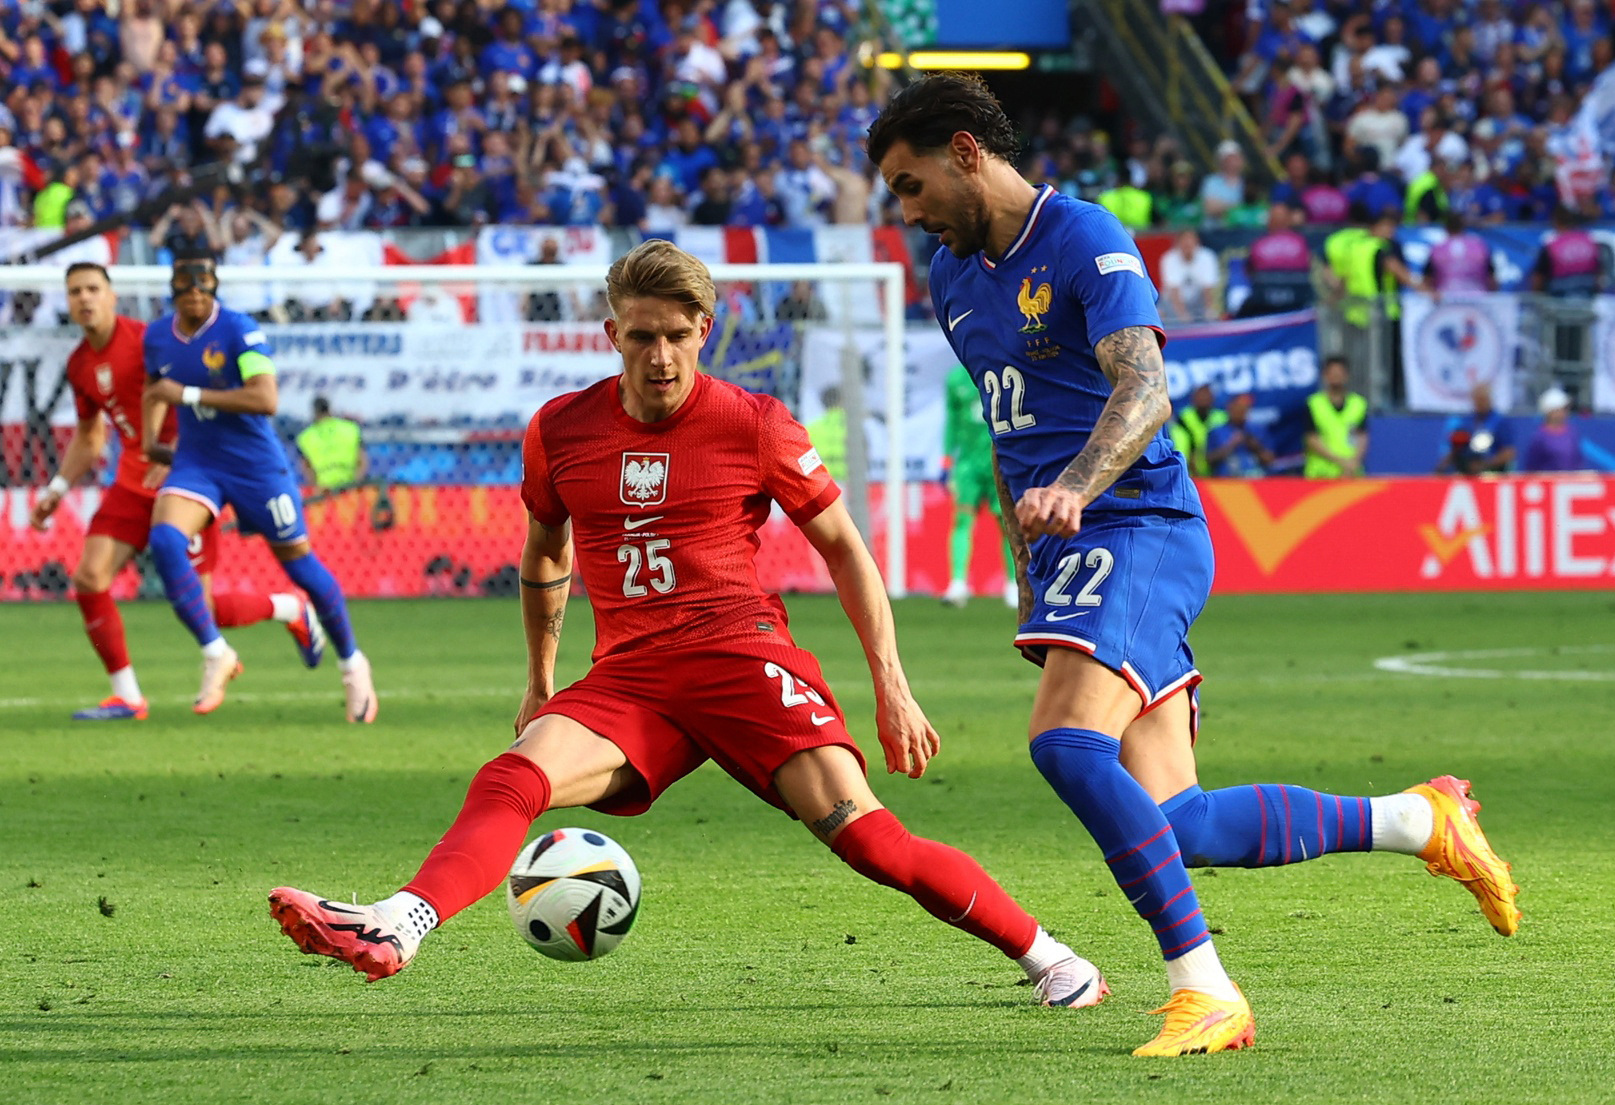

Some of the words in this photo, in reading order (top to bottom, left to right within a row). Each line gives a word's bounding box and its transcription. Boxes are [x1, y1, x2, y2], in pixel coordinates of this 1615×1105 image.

[984, 365, 1036, 435] 22
[265, 493, 298, 528] 10
[1420, 480, 1615, 578] AliE
[617, 538, 677, 598] 25
[1044, 547, 1114, 606] 22
